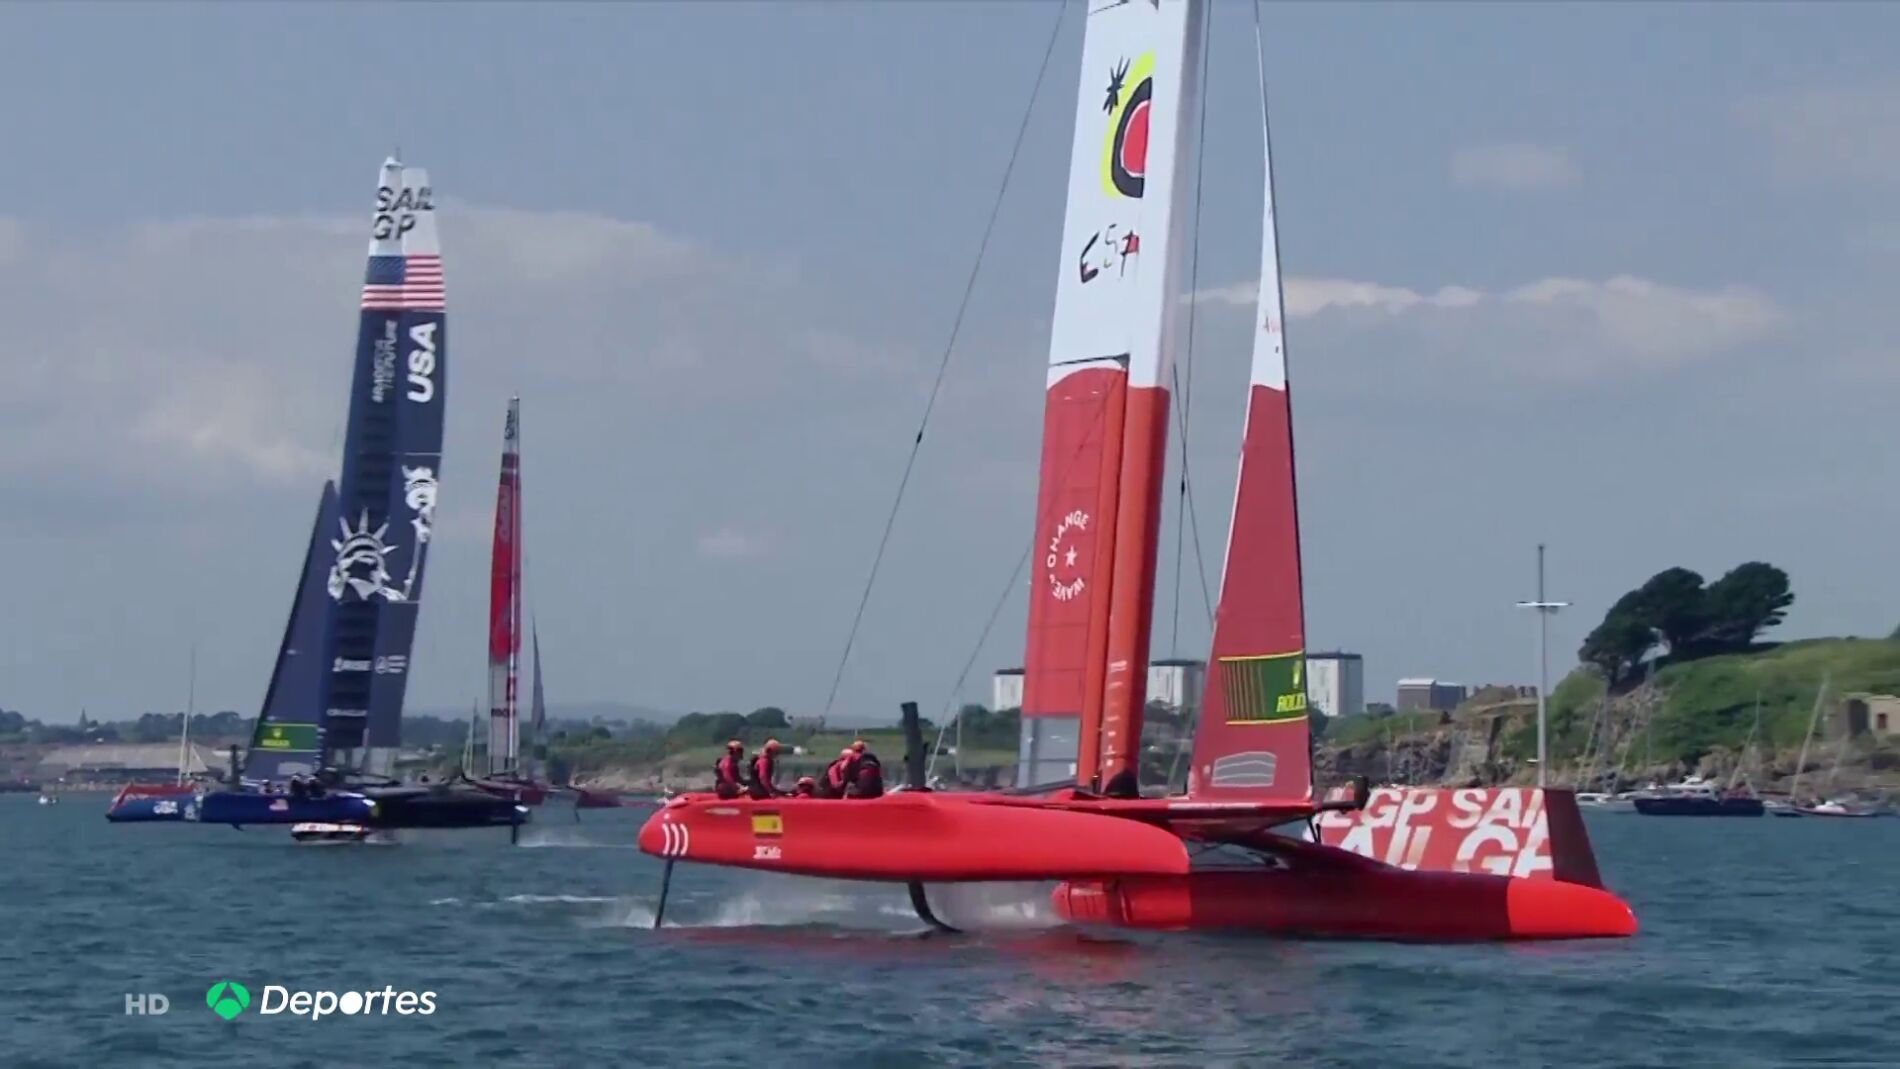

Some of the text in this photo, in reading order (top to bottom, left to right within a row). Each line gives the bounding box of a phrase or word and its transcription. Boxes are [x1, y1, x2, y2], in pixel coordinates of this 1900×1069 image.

[376, 186, 435, 211] SAIL
[373, 214, 416, 240] GP
[407, 322, 437, 403] USA
